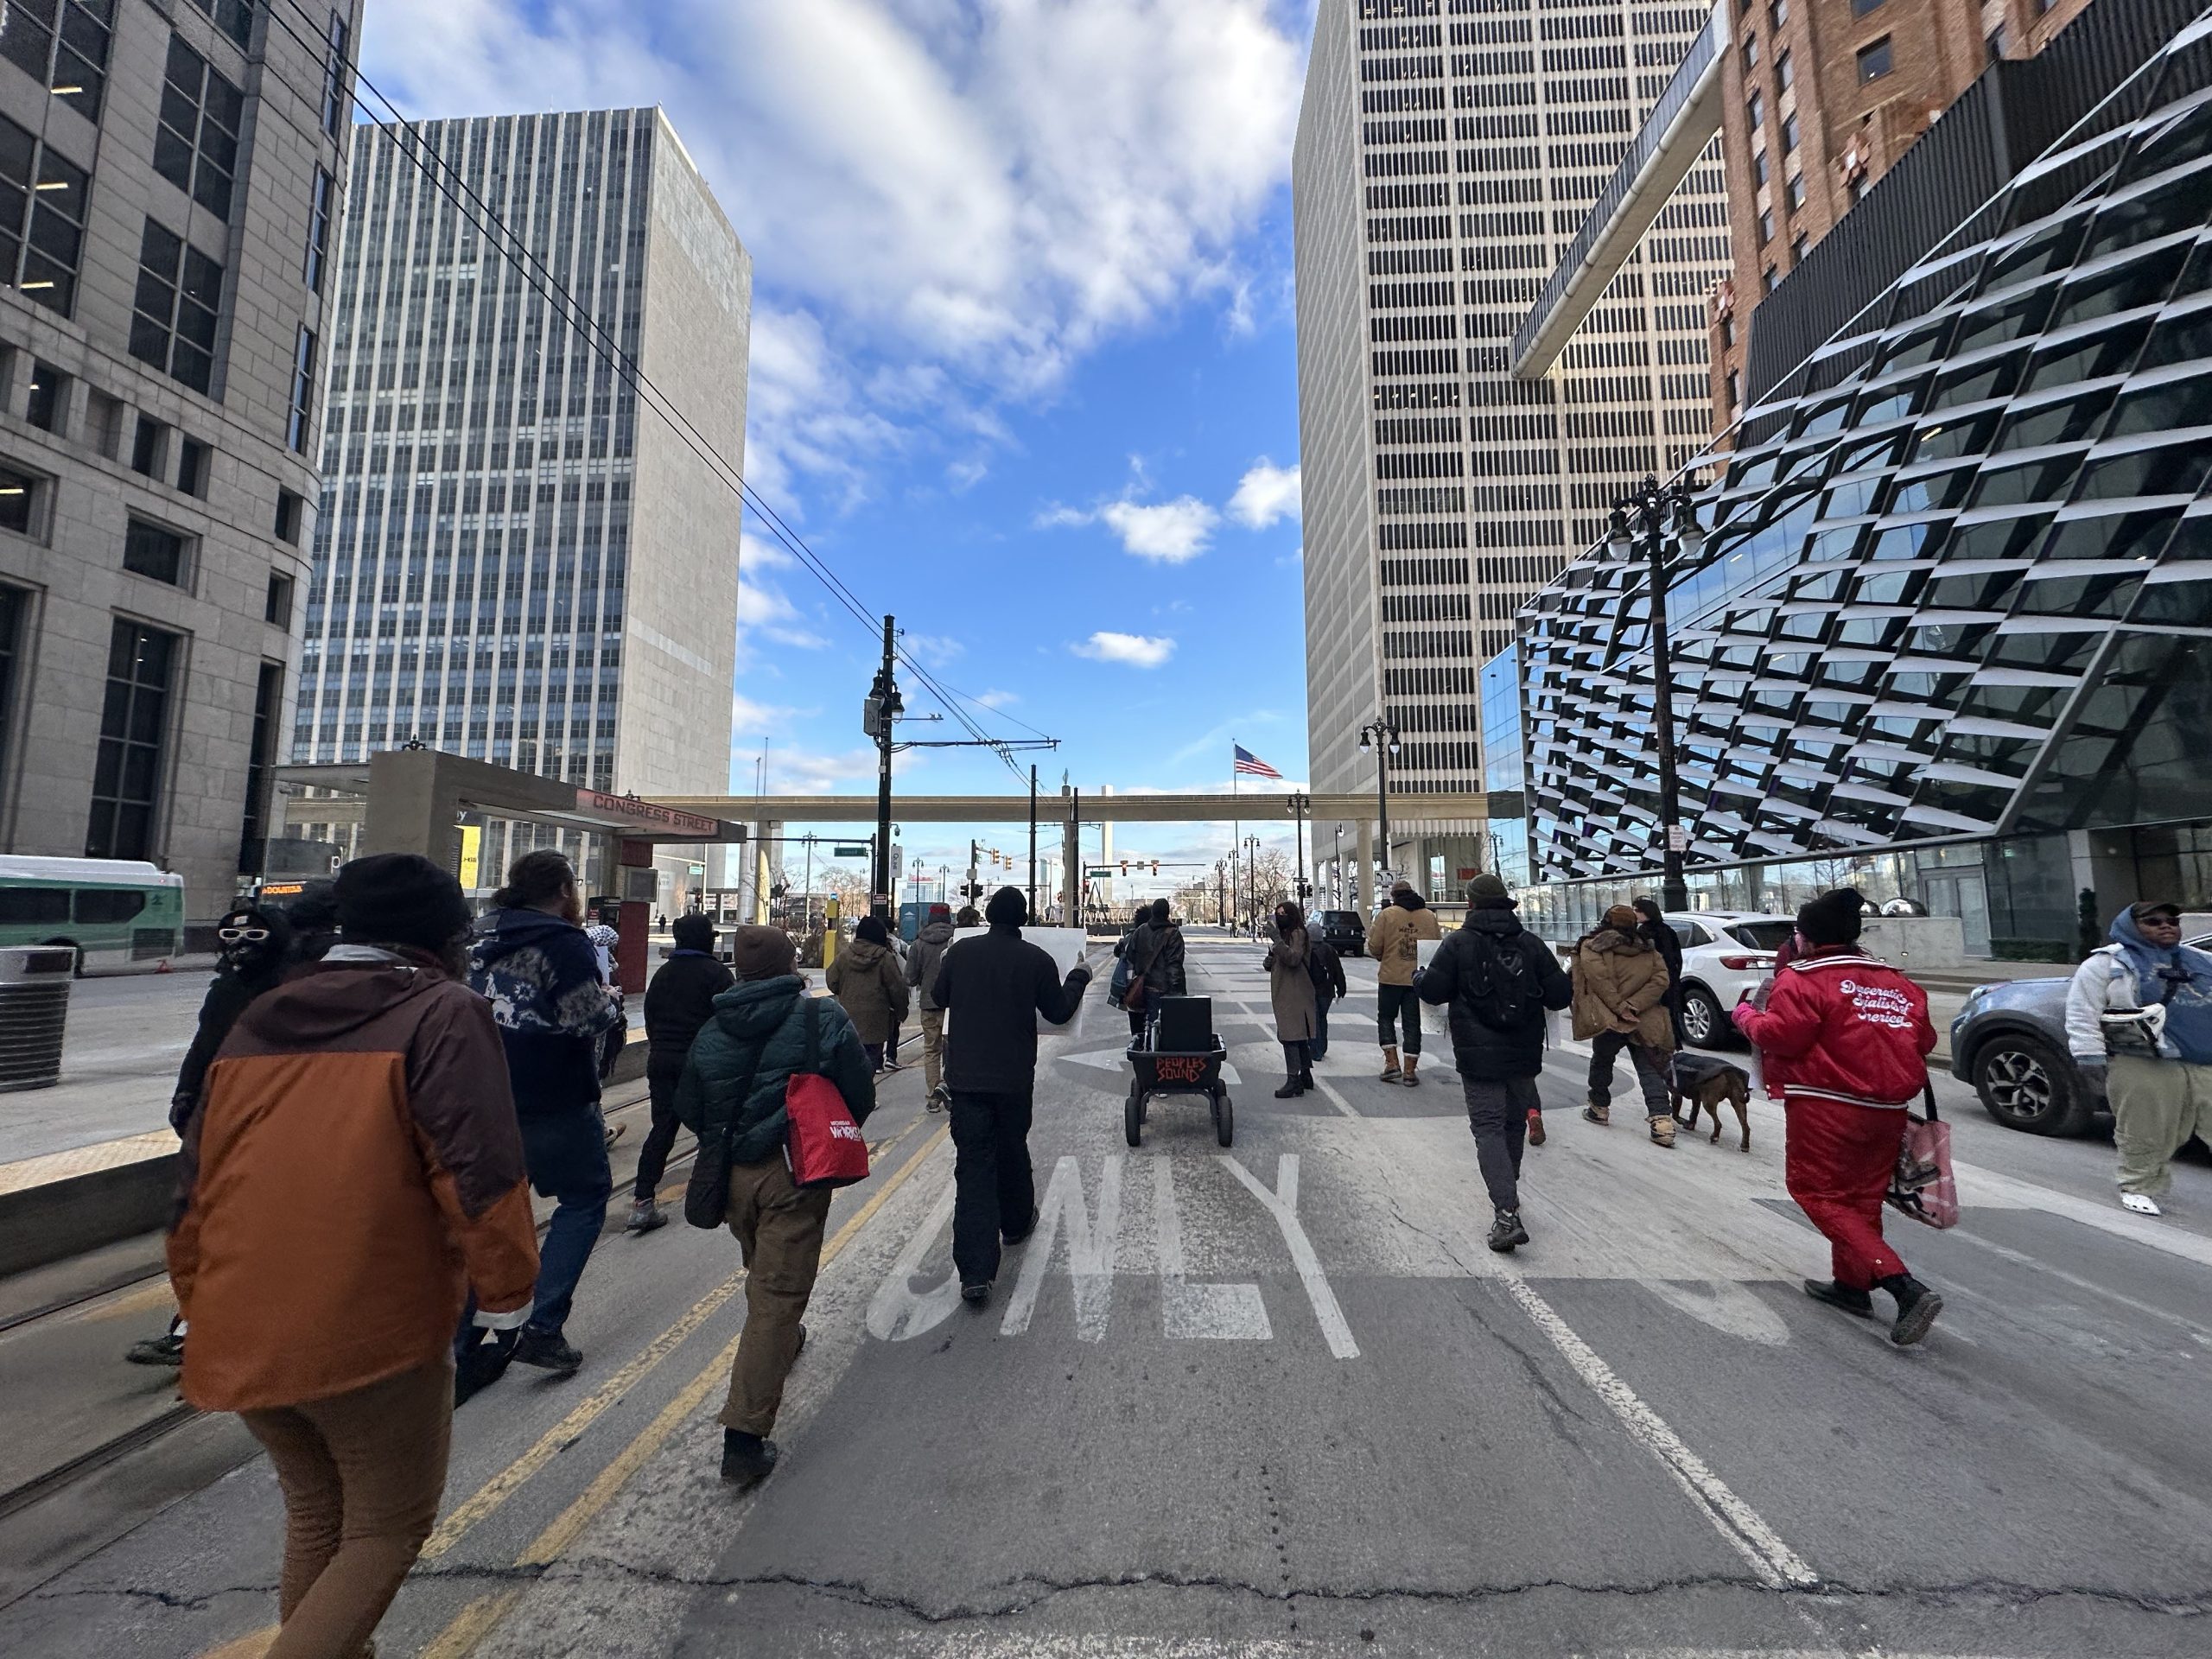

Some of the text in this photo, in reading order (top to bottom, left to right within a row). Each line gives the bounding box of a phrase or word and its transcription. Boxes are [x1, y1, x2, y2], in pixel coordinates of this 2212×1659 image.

[594, 795, 713, 832] CONGRESS STREET
[1156, 1057, 1207, 1072] PEOPLES
[1157, 1067, 1200, 1083] SOUND
